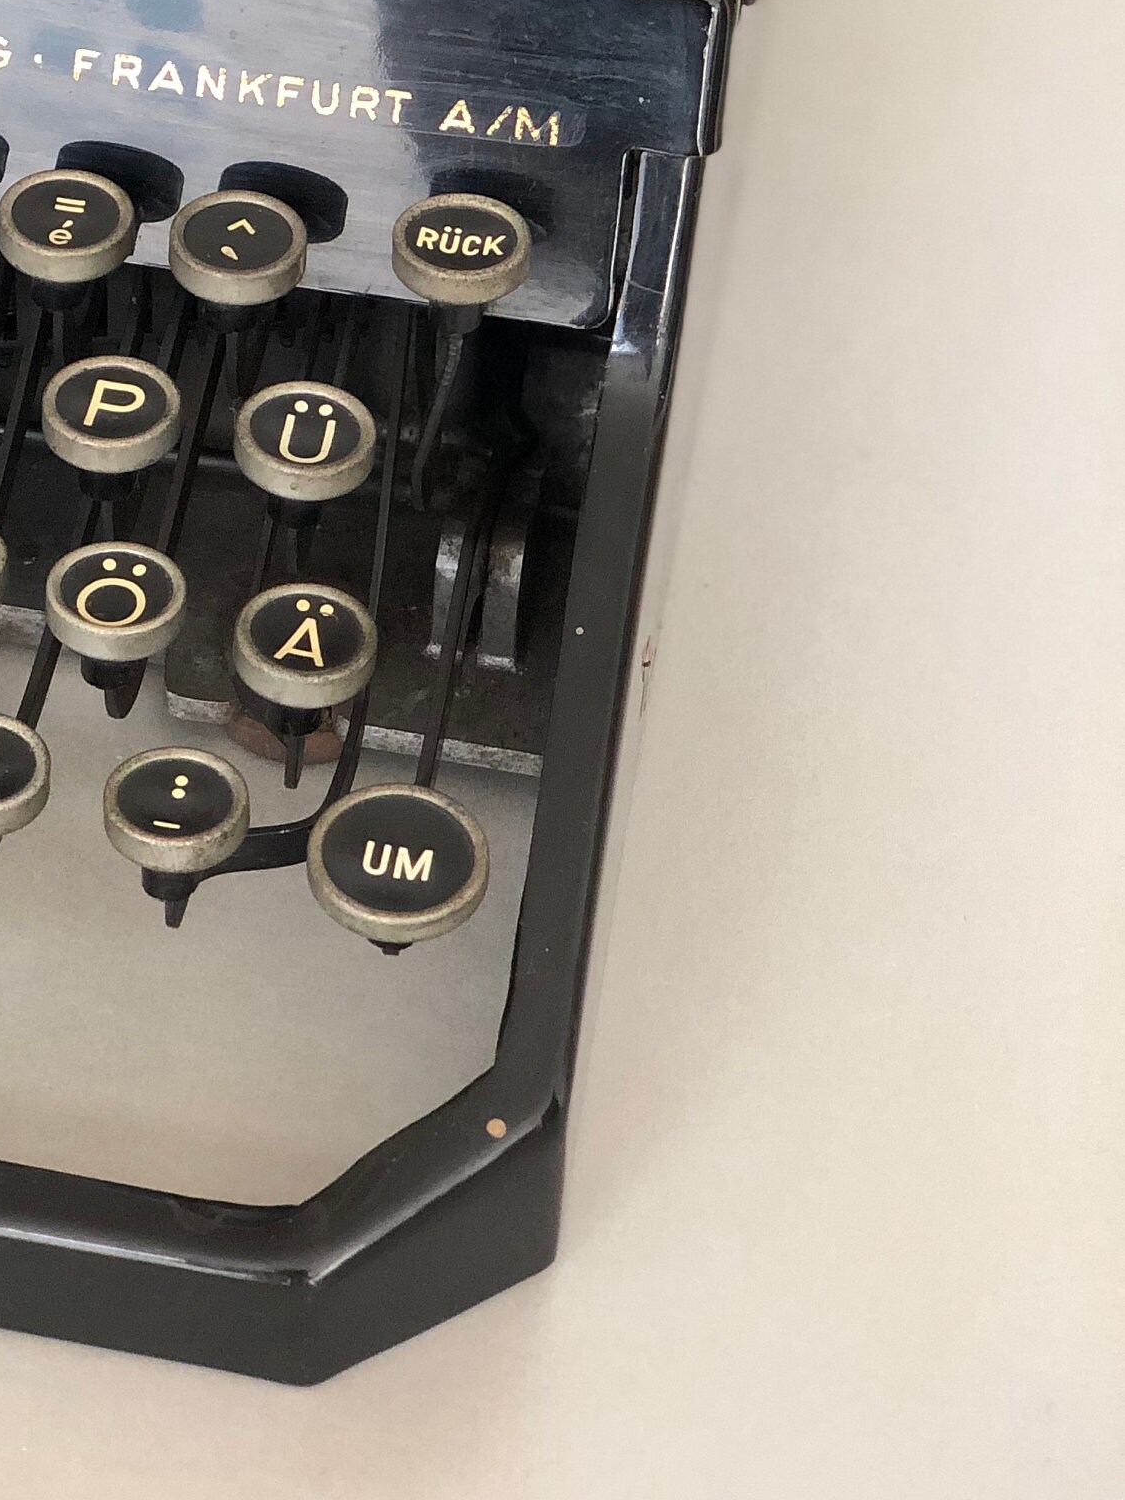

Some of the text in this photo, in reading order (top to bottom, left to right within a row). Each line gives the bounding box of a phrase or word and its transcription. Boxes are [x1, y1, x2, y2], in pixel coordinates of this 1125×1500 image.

[73, 48, 413, 124] FRANKFURT
[438, 99, 560, 146] A/M
[416, 225, 506, 257] RÜCK
[83, 379, 146, 427] P
[278, 400, 337, 464] Ü
[76, 558, 147, 627] Ö
[273, 599, 335, 668] Ä
[361, 839, 435, 882] UM
